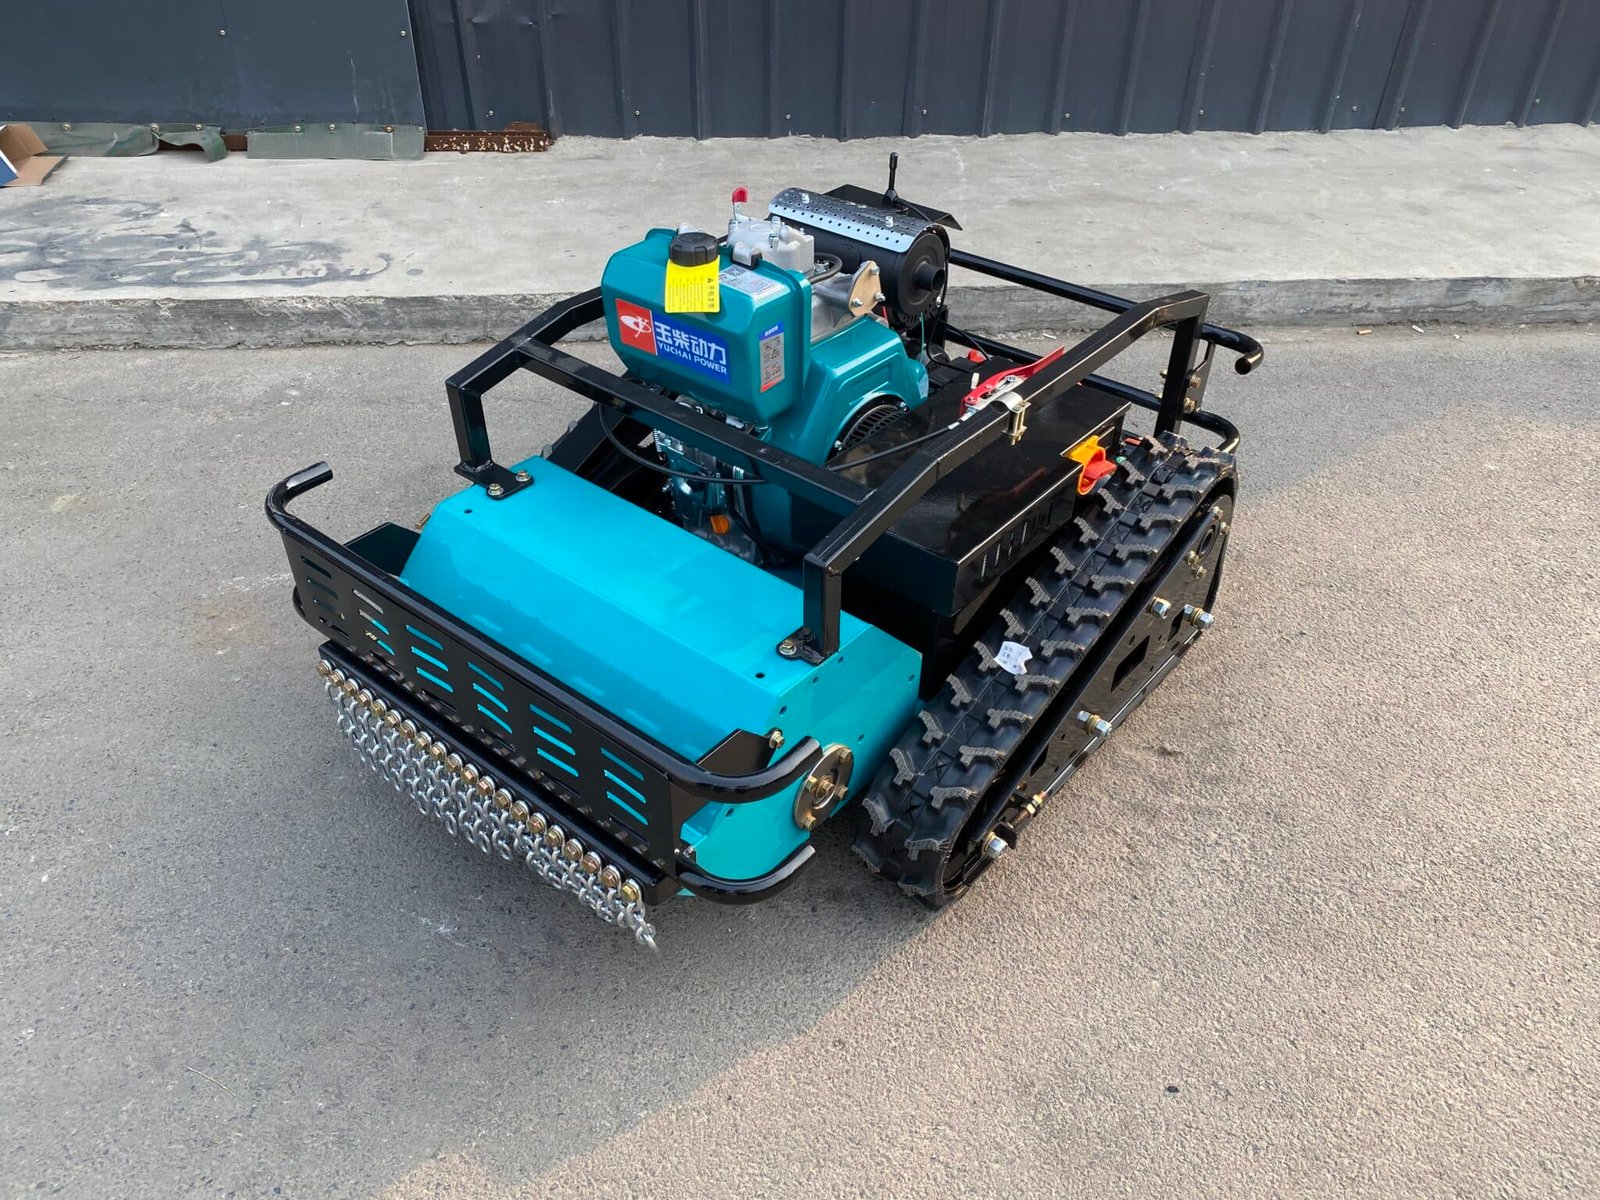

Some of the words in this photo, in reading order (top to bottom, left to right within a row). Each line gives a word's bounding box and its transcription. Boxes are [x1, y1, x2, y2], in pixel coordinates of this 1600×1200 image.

[654, 321, 727, 366] 玉柴动力
[656, 341, 692, 361] YUCHAI
[693, 355, 728, 375] POWER
